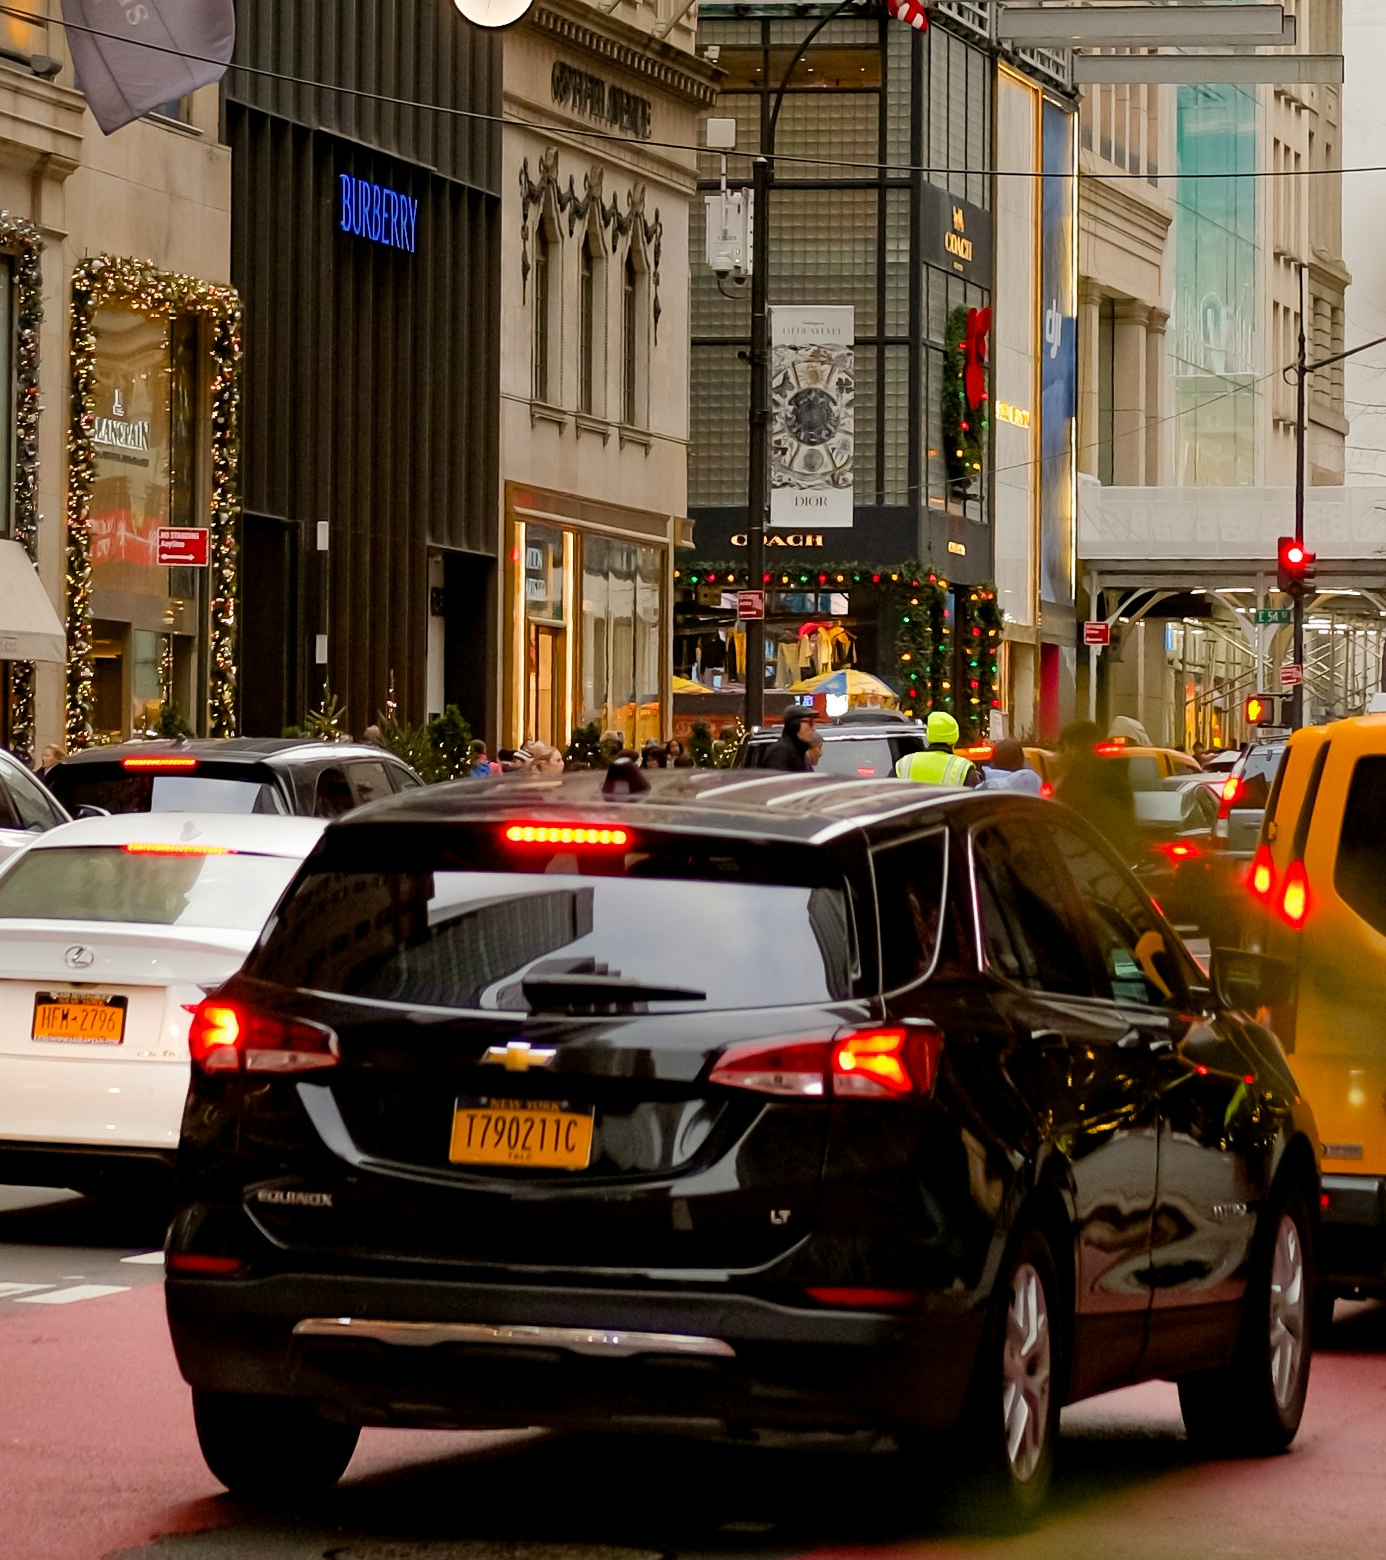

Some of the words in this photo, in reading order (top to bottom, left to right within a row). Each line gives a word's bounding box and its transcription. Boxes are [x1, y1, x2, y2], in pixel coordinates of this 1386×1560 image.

[338, 173, 418, 253] BURBERRY
[944, 231, 973, 262] COACH
[95, 417, 149, 451] LANCPAIN
[794, 496, 829, 508] DIOR
[160, 540, 186, 550] Anytime
[730, 534, 824, 547] CACH
[1258, 610, 1265, 622] E
[1266, 610, 1279, 622] 54
[490, 1097, 521, 1109] NEW
[527, 1100, 561, 1111] YORK
[467, 1113, 578, 1152] T790211C
[257, 1189, 333, 1208] EQUINOX
[770, 1209, 792, 1225] LT
